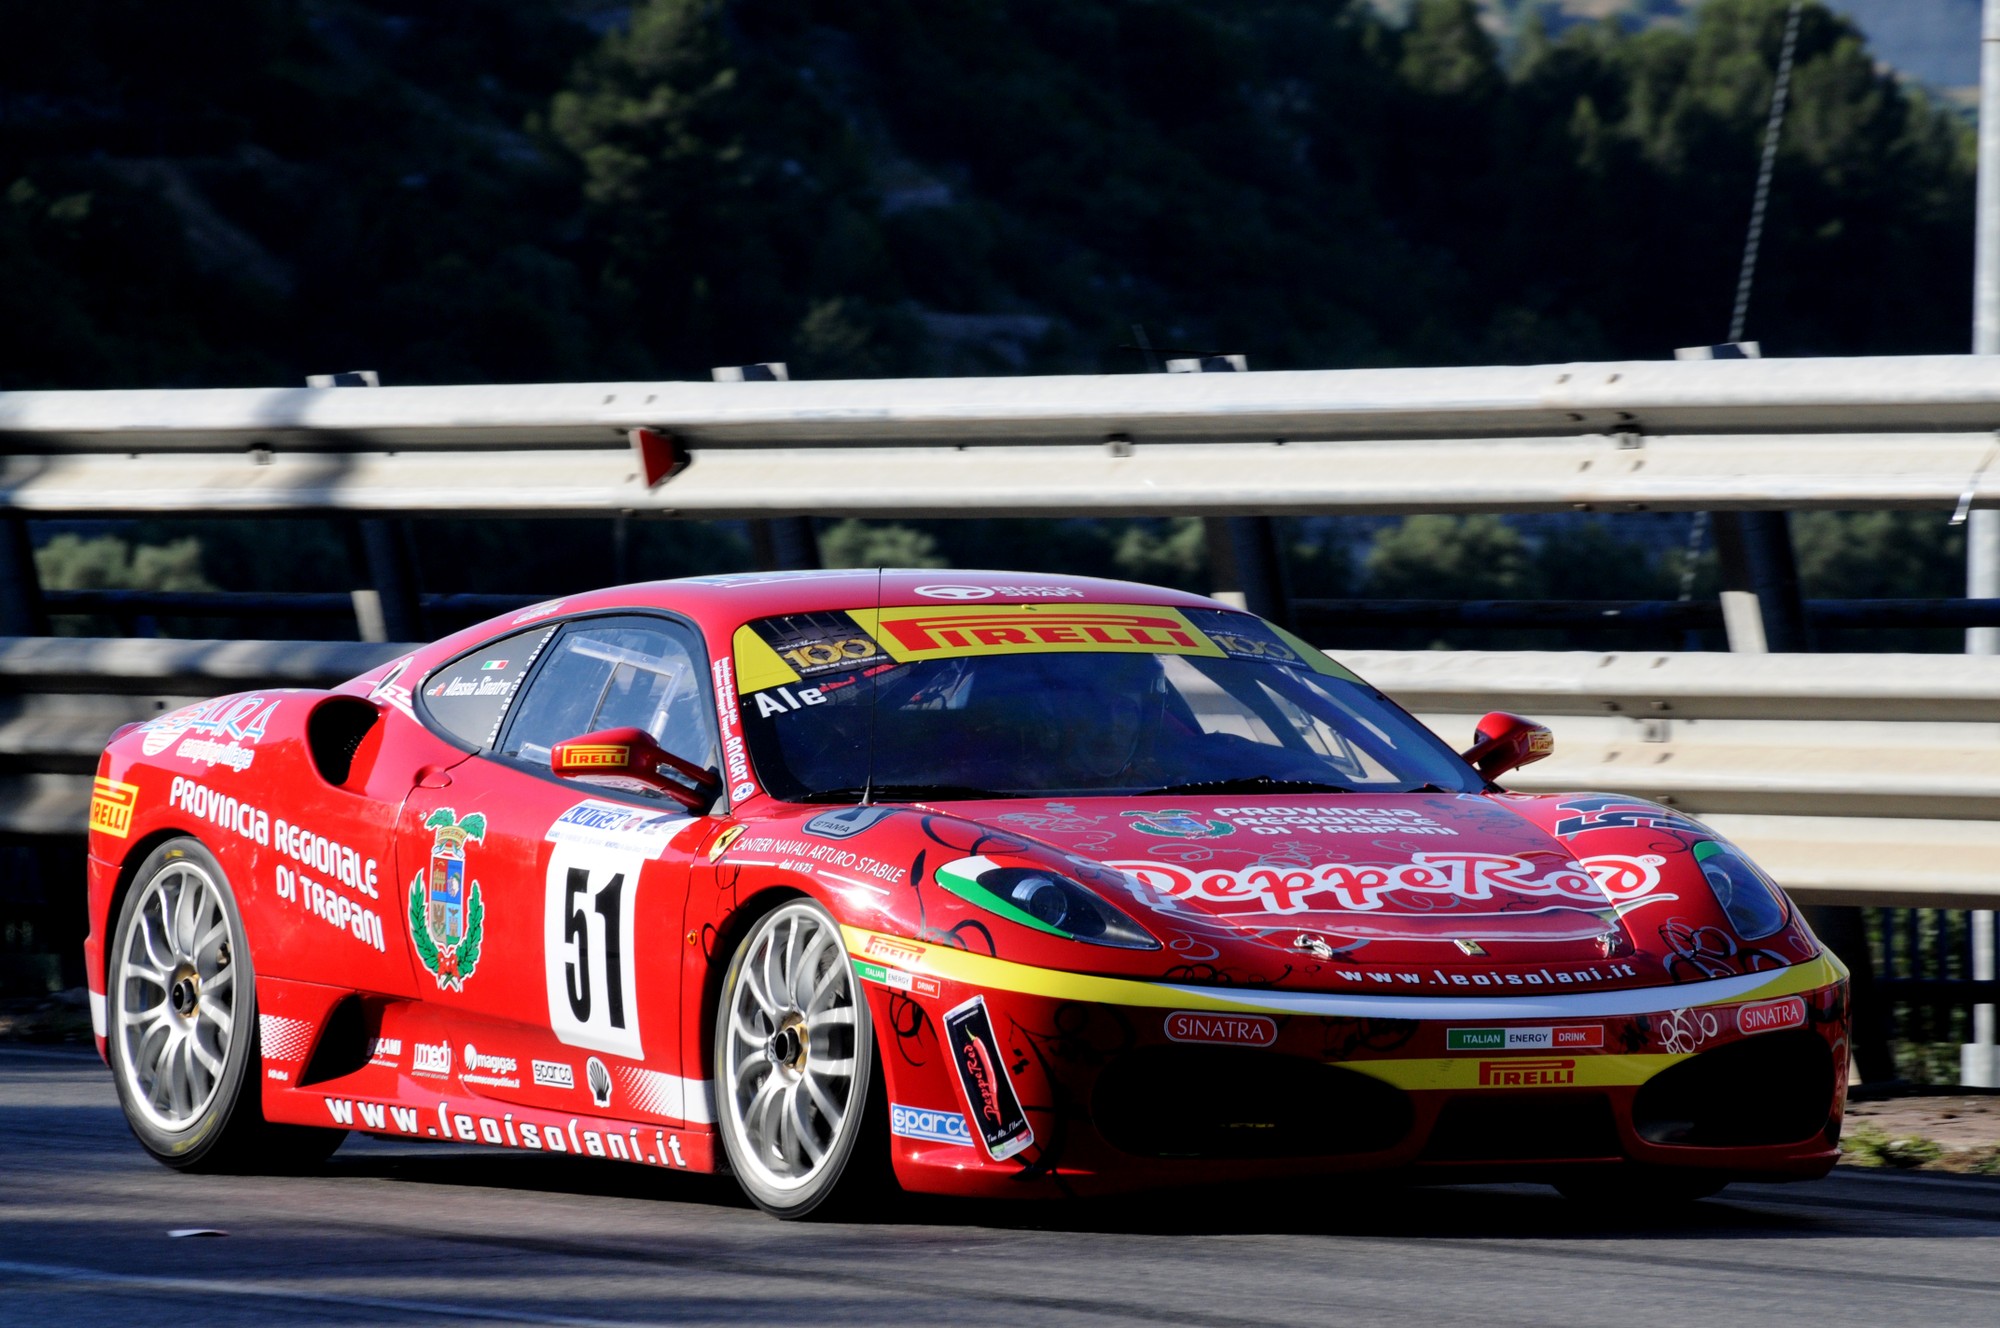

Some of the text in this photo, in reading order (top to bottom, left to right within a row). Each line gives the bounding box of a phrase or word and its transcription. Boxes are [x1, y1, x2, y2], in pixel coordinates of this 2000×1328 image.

[1004, 590, 1085, 598] SHAFT
[880, 613, 1200, 652] PIRELLI
[783, 637, 877, 668] 100
[442, 676, 479, 697] Alessia
[474, 675, 512, 696] Sinatra
[754, 686, 828, 719] Ale
[565, 748, 626, 765] PIRELLI
[812, 820, 851, 834] STAMA
[732, 837, 907, 884] CANTIERI NAVALI ARTURO STABILE
[778, 858, 814, 874] dal 1875
[564, 866, 626, 1030] 51
[865, 967, 936, 993] ITALIAN ENERGY DRINK
[1745, 1002, 1800, 1029] SINATRA
[1177, 1017, 1265, 1041] SINATRA
[1462, 1031, 1587, 1044] ITALIAN ENERGY DRINK
[534, 1063, 572, 1082] sparco
[1479, 1059, 1576, 1086] PIRELLI
